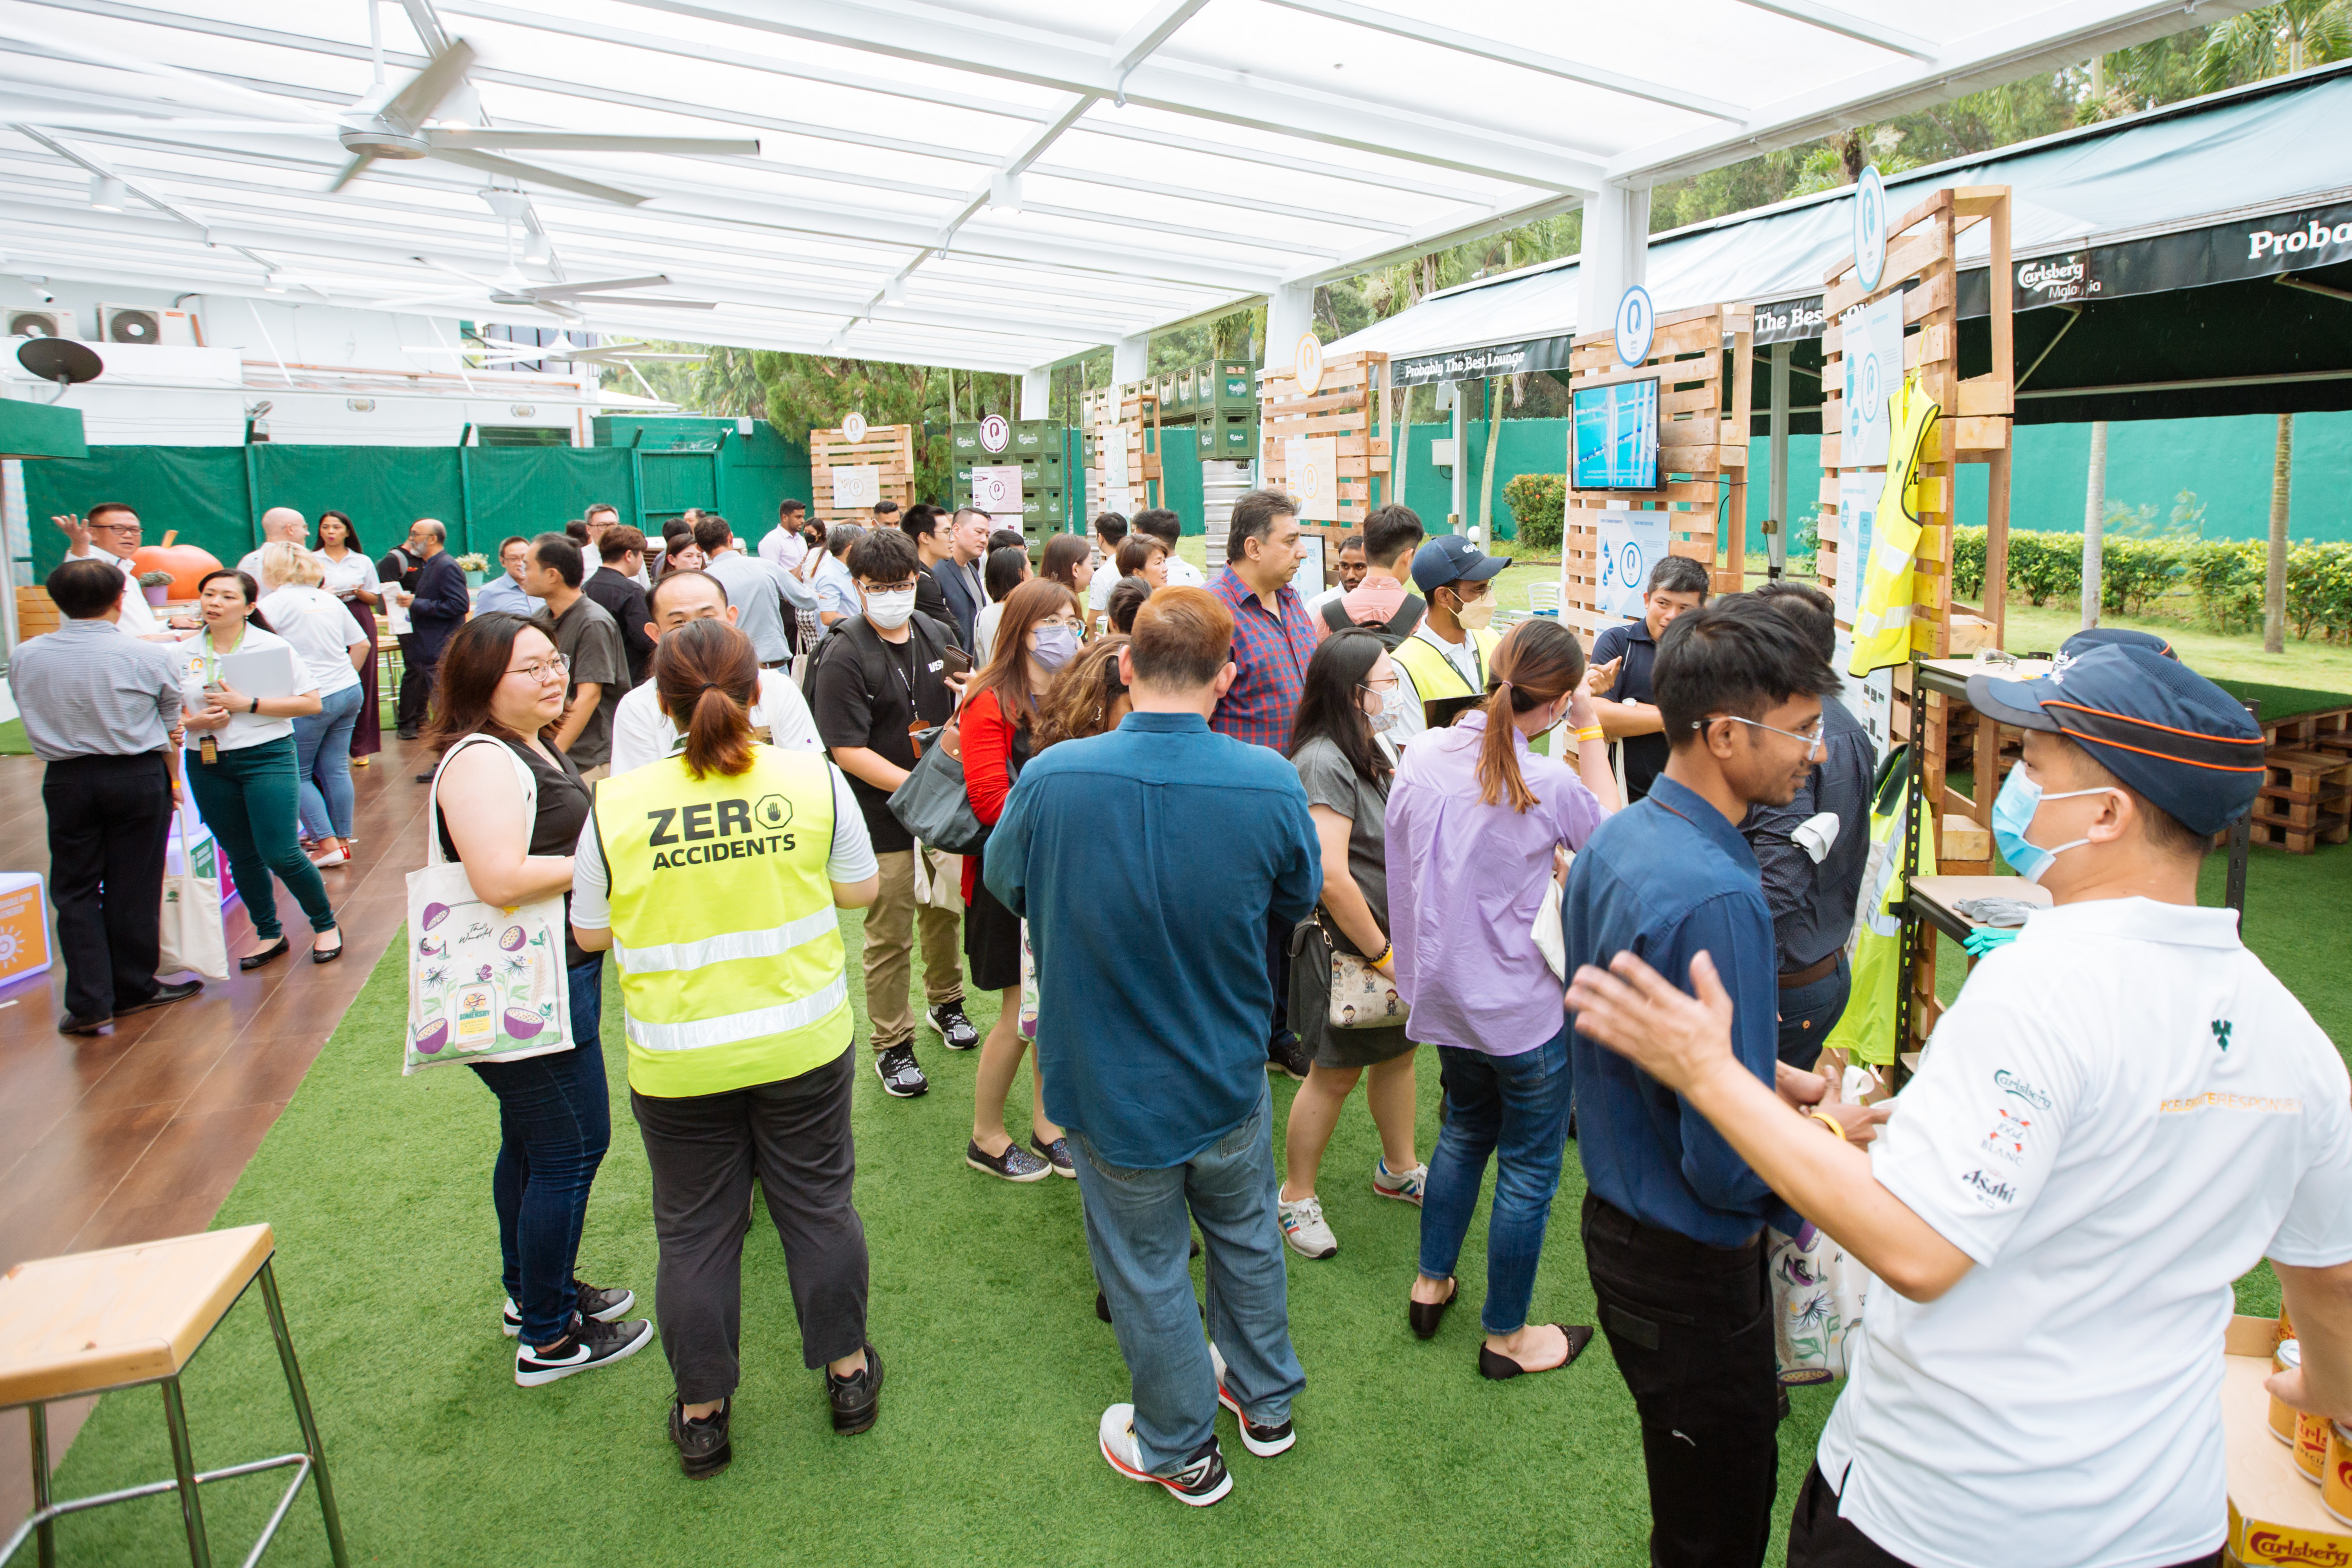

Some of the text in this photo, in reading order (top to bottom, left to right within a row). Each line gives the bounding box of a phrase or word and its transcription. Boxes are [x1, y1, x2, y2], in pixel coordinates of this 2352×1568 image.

[2018, 256, 2085, 292] Carlsberg
[1755, 312, 1787, 332] The
[1790, 308, 1827, 328] Bes
[1405, 351, 1525, 378] Probably The Best Lounge
[957, 437, 975, 448] Carlsberg
[653, 833, 796, 871] ACCIDENTS
[459, 1010, 490, 1021] SOMERSBY
[1995, 1069, 2052, 1110] Carlsberg
[1981, 1140, 2025, 1167] BLANC
[1963, 1170, 2017, 1204] Asahi
[2250, 1531, 2350, 1567] Carlsberg
